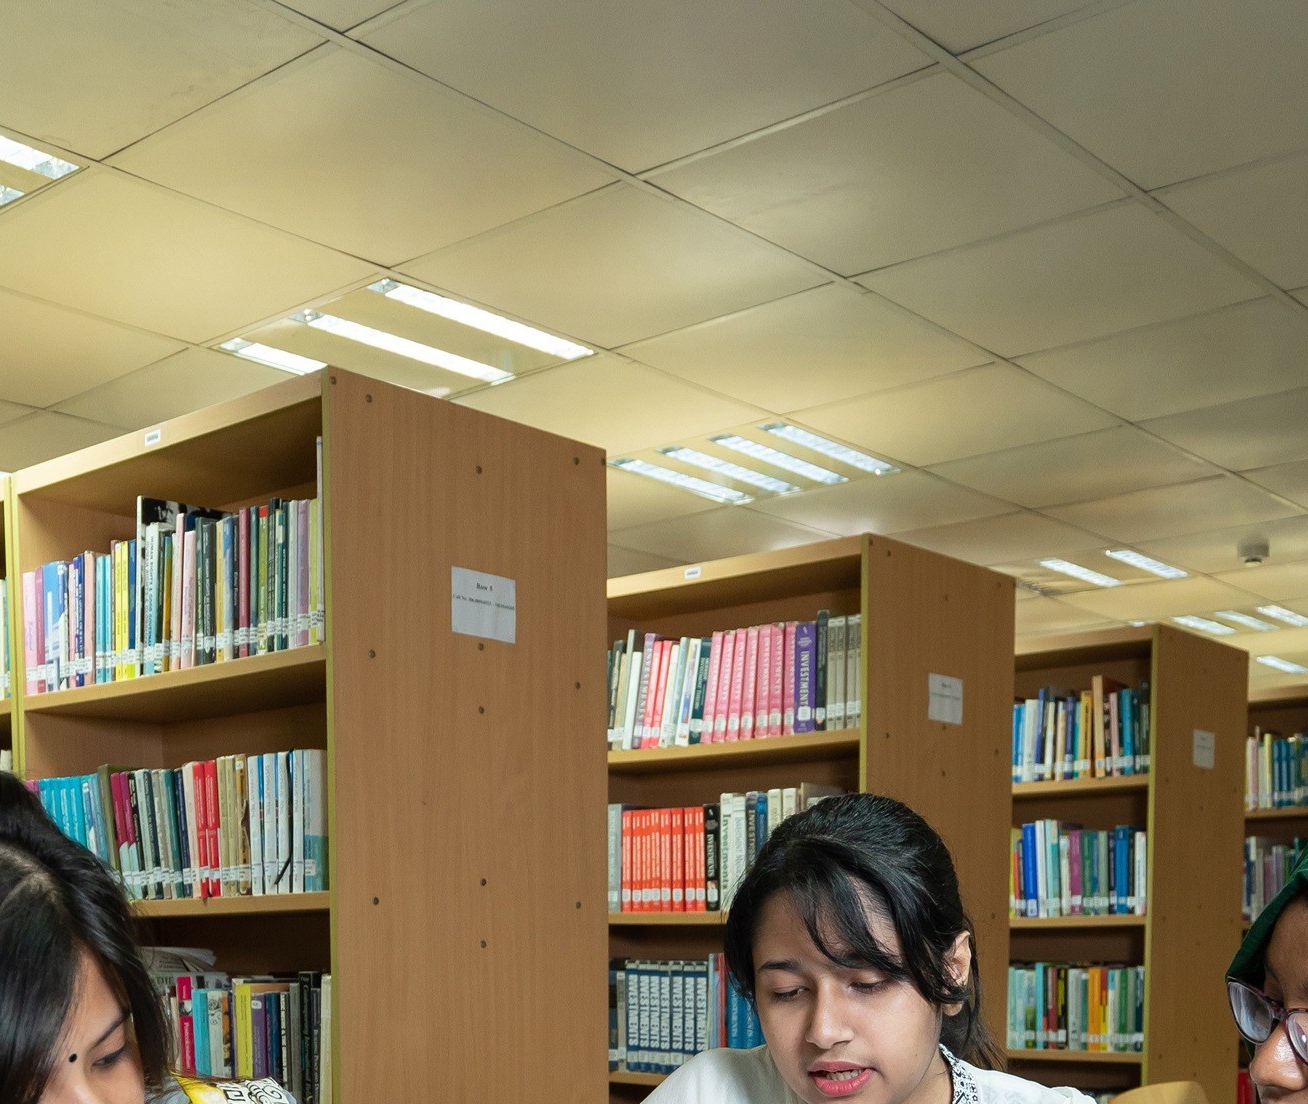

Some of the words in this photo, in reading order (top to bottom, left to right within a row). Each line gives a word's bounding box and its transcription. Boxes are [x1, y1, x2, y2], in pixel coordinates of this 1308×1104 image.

[476, 583, 488, 591] Row
[707, 834, 715, 877] INVESTMENTS
[722, 813, 732, 890] Investments
[628, 974, 638, 1046] INVESTMENTS
[640, 975, 649, 1048] INVESTMENTS
[650, 975, 660, 1048] INVESTMENTS
[661, 976, 670, 1049] INVESTMENTS
[672, 976, 682, 1049] INVESTMENTS
[685, 976, 694, 1050] INVESTMENTS
[696, 977, 706, 1050] INVESTMENTS
